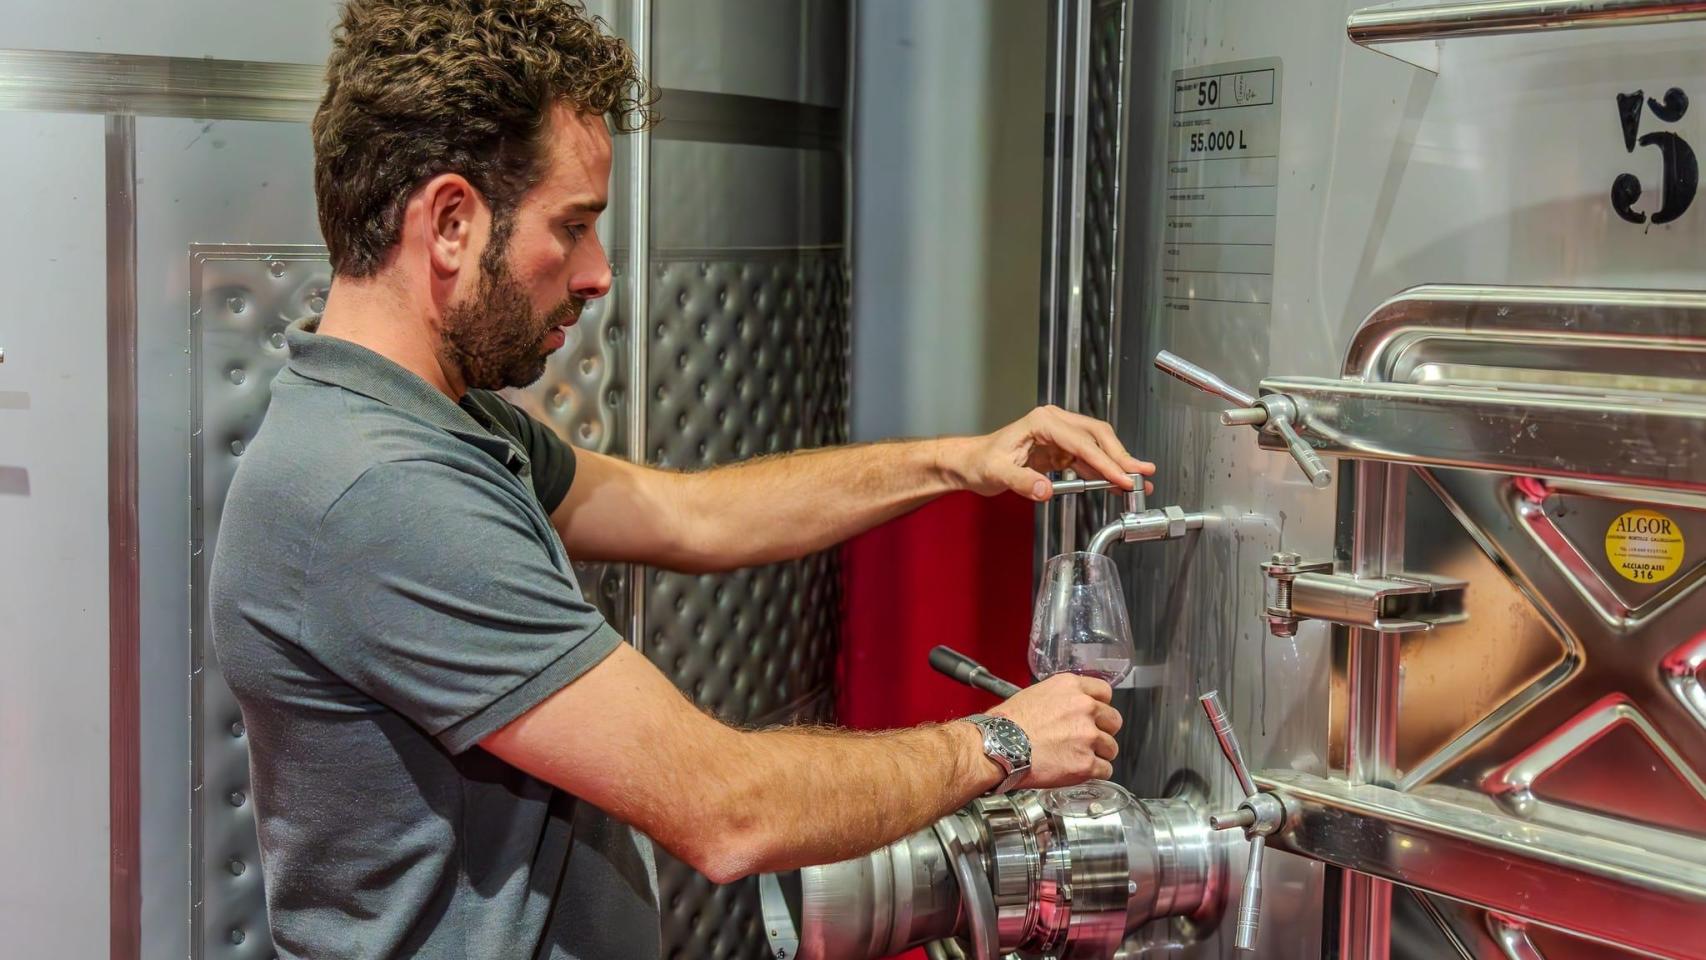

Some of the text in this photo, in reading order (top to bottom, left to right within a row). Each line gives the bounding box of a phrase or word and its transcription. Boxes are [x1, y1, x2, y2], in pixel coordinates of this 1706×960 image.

[1198, 80, 1218, 106] 50
[1190, 129, 1247, 152] 55.000 L
[1611, 87, 1698, 224] 5
[1616, 517, 1671, 535] ALGOR
[1633, 570, 1653, 579] 316
